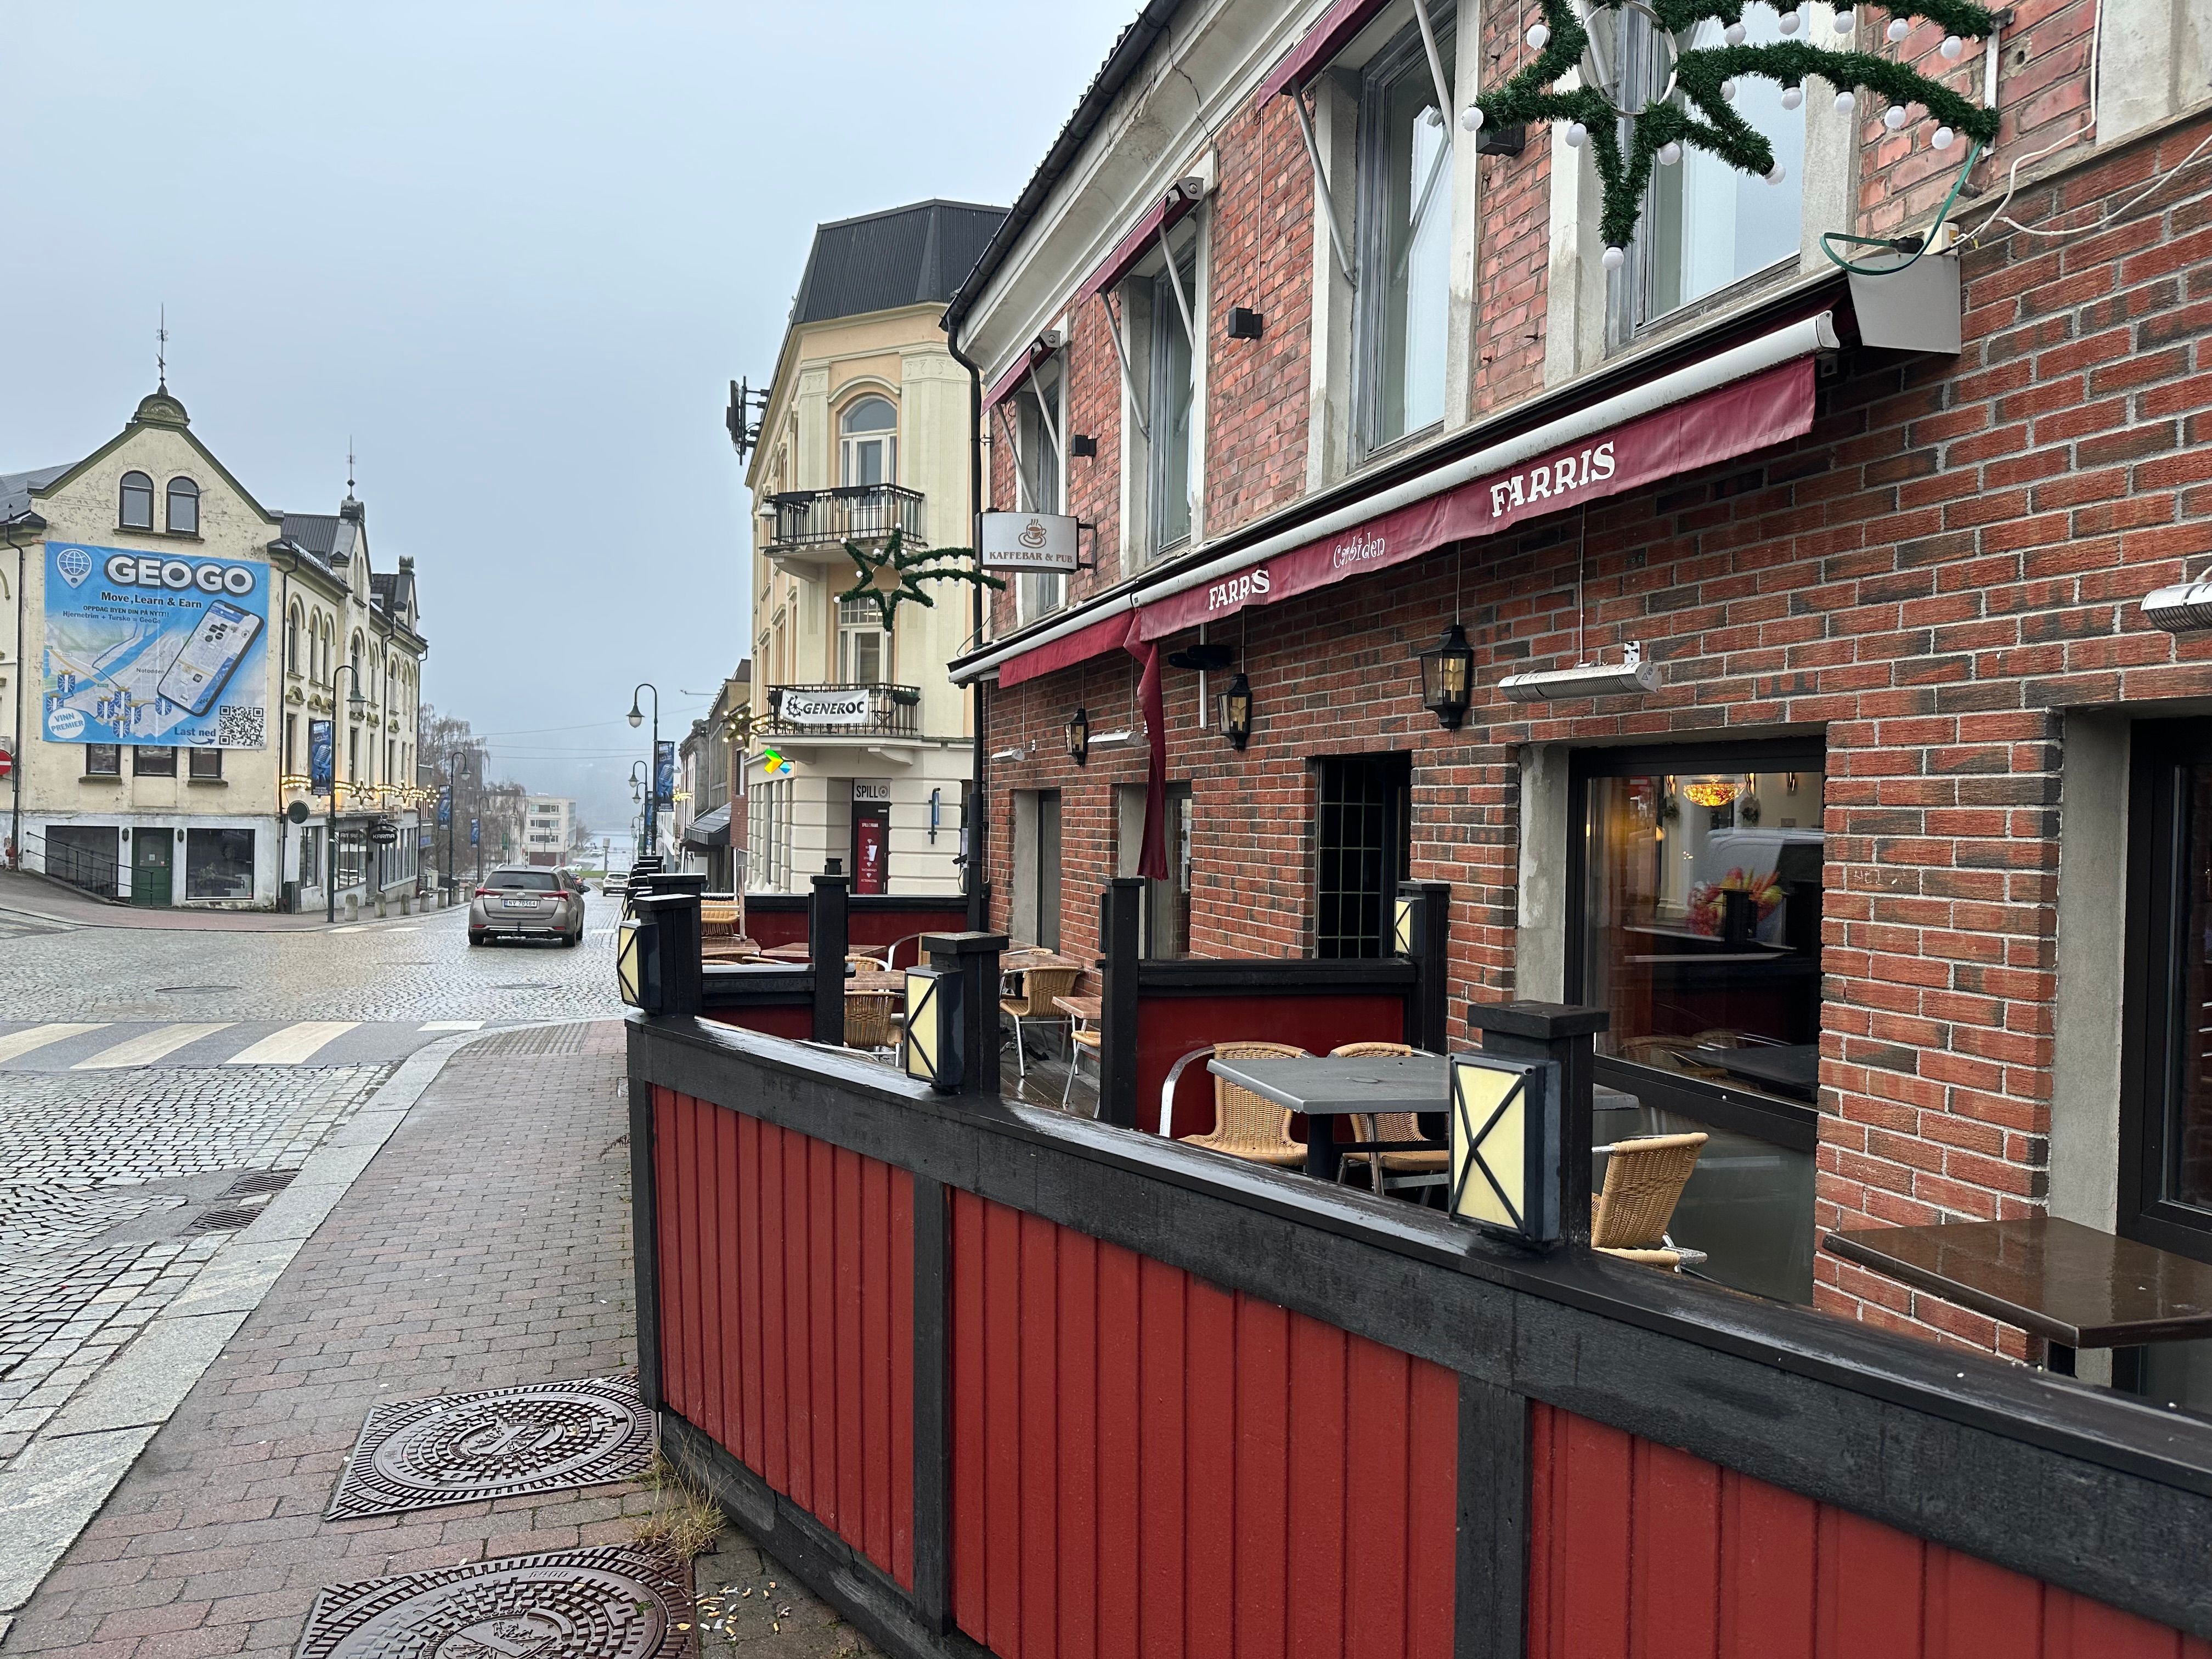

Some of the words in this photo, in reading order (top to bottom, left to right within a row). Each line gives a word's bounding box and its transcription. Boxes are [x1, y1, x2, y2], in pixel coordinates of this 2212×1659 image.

[1490, 441, 1615, 518] FARRIS
[1333, 532, 1385, 568] Carbiden
[989, 551, 1042, 561] KAFFEBAR
[1045, 553, 1053, 561] &
[1056, 554, 1073, 563] PUB
[106, 556, 254, 595] GEOGO
[1209, 569, 1270, 611] FARRS
[167, 597, 176, 606] &
[179, 598, 202, 608] Earn
[63, 610, 99, 620] Hjernetrim
[803, 701, 865, 715] GENEROC
[54, 713, 75, 723] VINN
[50, 719, 84, 732] PREMIER
[174, 726, 195, 736] Last
[199, 728, 216, 737] ned
